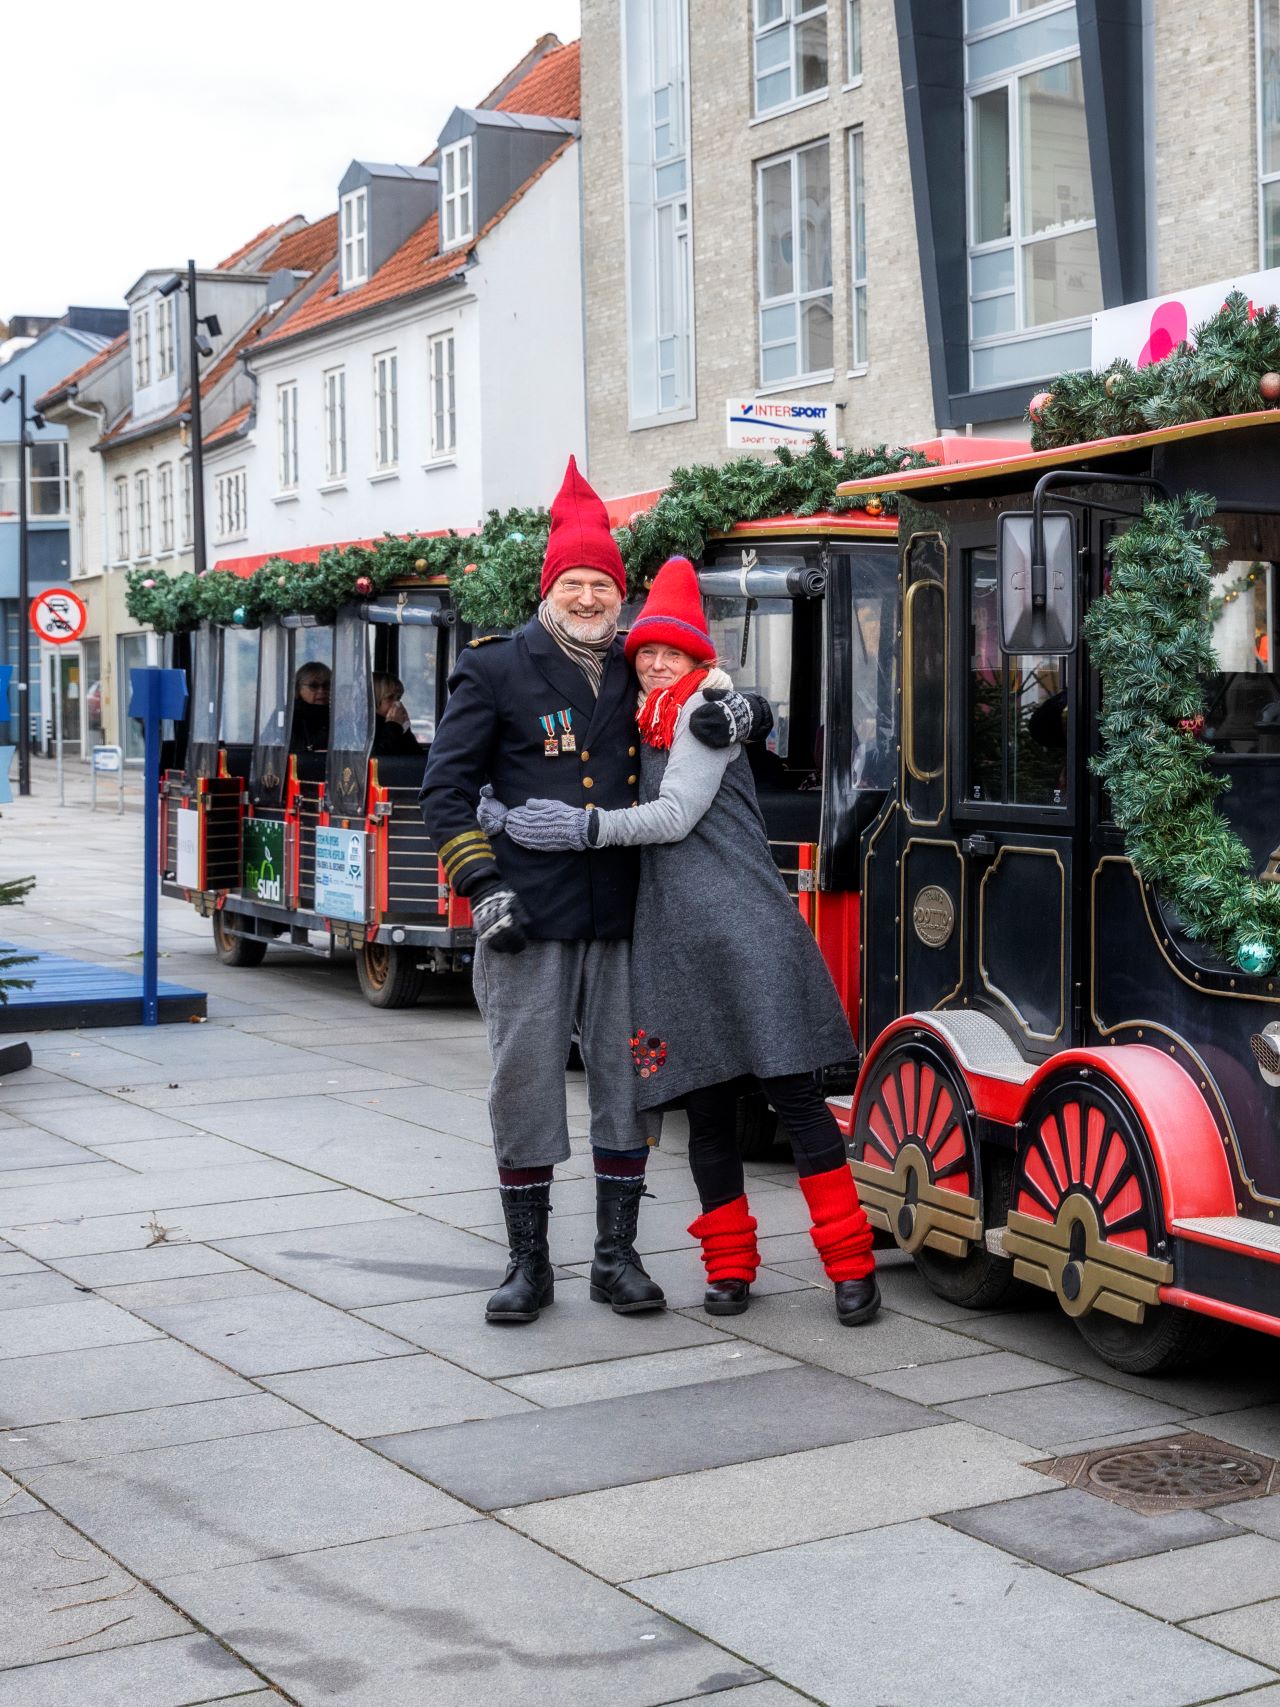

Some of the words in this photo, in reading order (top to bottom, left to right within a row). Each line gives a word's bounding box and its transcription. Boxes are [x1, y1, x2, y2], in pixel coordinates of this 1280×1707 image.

[755, 404, 828, 418] INTERSPORT
[741, 436, 765, 445] SPORT
[769, 437, 780, 445] TO
[257, 874, 280, 902] sund
